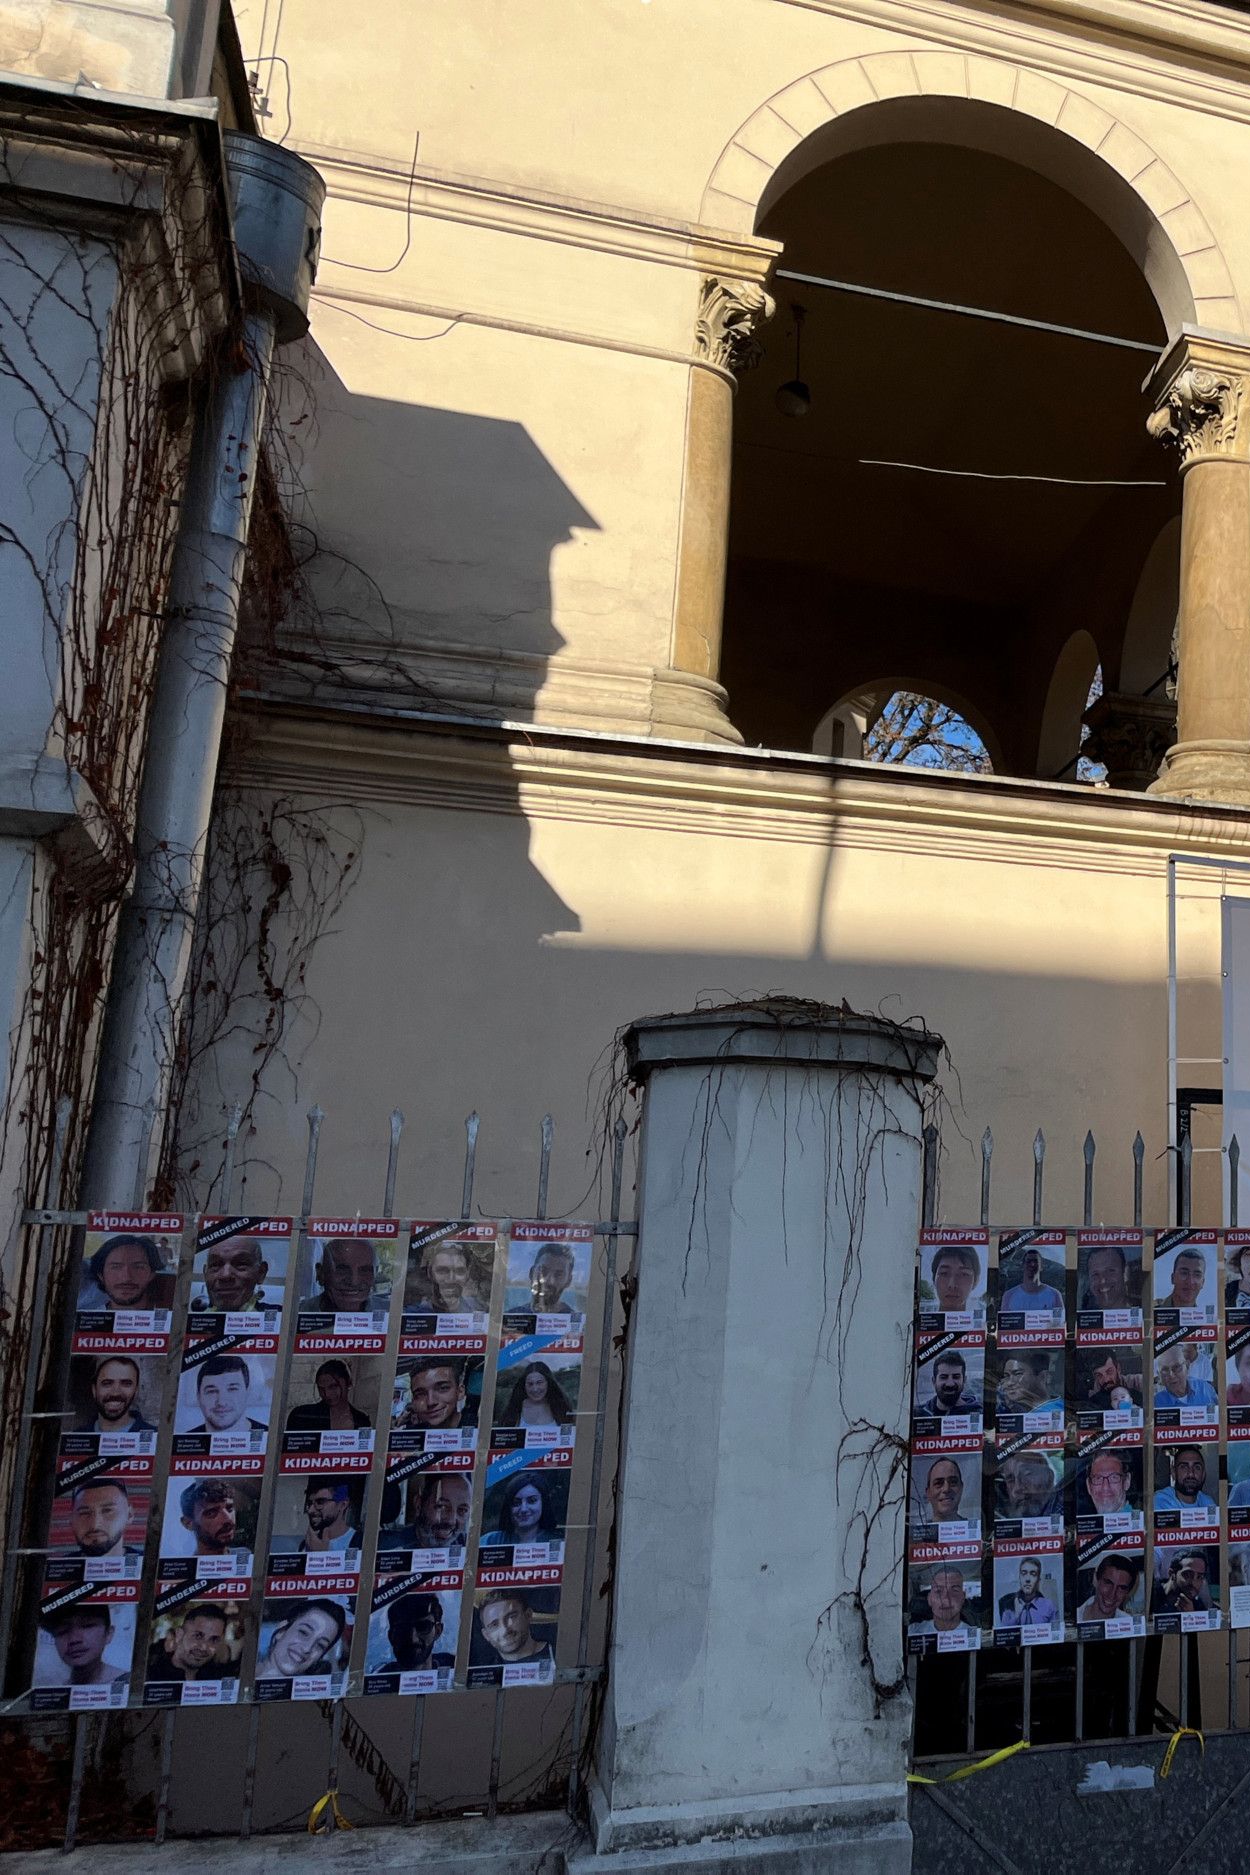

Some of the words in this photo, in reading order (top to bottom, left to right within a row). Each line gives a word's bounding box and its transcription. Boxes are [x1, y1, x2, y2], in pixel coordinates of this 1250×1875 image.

[93, 1215, 180, 1230] KIDNAPPED
[313, 1222, 395, 1234] KIDNAPPED
[199, 1217, 250, 1246] MURDERED
[411, 1222, 459, 1250] MURDERED
[516, 1226, 590, 1239] KIDNAPPED
[923, 1232, 986, 1241] KIDNAPPED
[1081, 1232, 1140, 1241] KIDNAPPED
[1000, 1230, 1035, 1254] MURDERED
[1156, 1229, 1189, 1253] MURDERED
[78, 1337, 165, 1349] KIDNAPPED
[300, 1338, 382, 1350] KIDNAPPED
[1001, 1333, 1062, 1343] KIDNAPPED
[1080, 1332, 1140, 1342] KIDNAPPED
[1155, 1326, 1188, 1351] MURDERED
[185, 1335, 236, 1364] MURDERED
[404, 1339, 483, 1350] KIDNAPPED
[510, 1341, 533, 1357] FREED
[919, 1332, 955, 1361] MURDERED
[1157, 1429, 1216, 1440] KIDNAPPED
[916, 1439, 980, 1450] KIDNAPPED
[997, 1433, 1033, 1460] MURDERED
[1077, 1431, 1113, 1457] MURDERED
[175, 1459, 261, 1471] KIDNAPPED
[285, 1457, 369, 1469] KIDNAPPED
[387, 1452, 435, 1483] MURDERED
[499, 1456, 523, 1472] FREED
[60, 1458, 107, 1487] MURDERED
[1157, 1531, 1217, 1542] KIDNAPPED
[913, 1544, 979, 1557] KIDNAPPED
[997, 1540, 1061, 1553] KIDNAPPED
[1078, 1534, 1113, 1561] MURDERED
[481, 1570, 559, 1582] KIDNAPPED
[271, 1579, 355, 1592] KIDNAPPED
[374, 1573, 423, 1605] MURDERED
[42, 1582, 94, 1615] MURDERED
[156, 1580, 208, 1611] MURDERED
